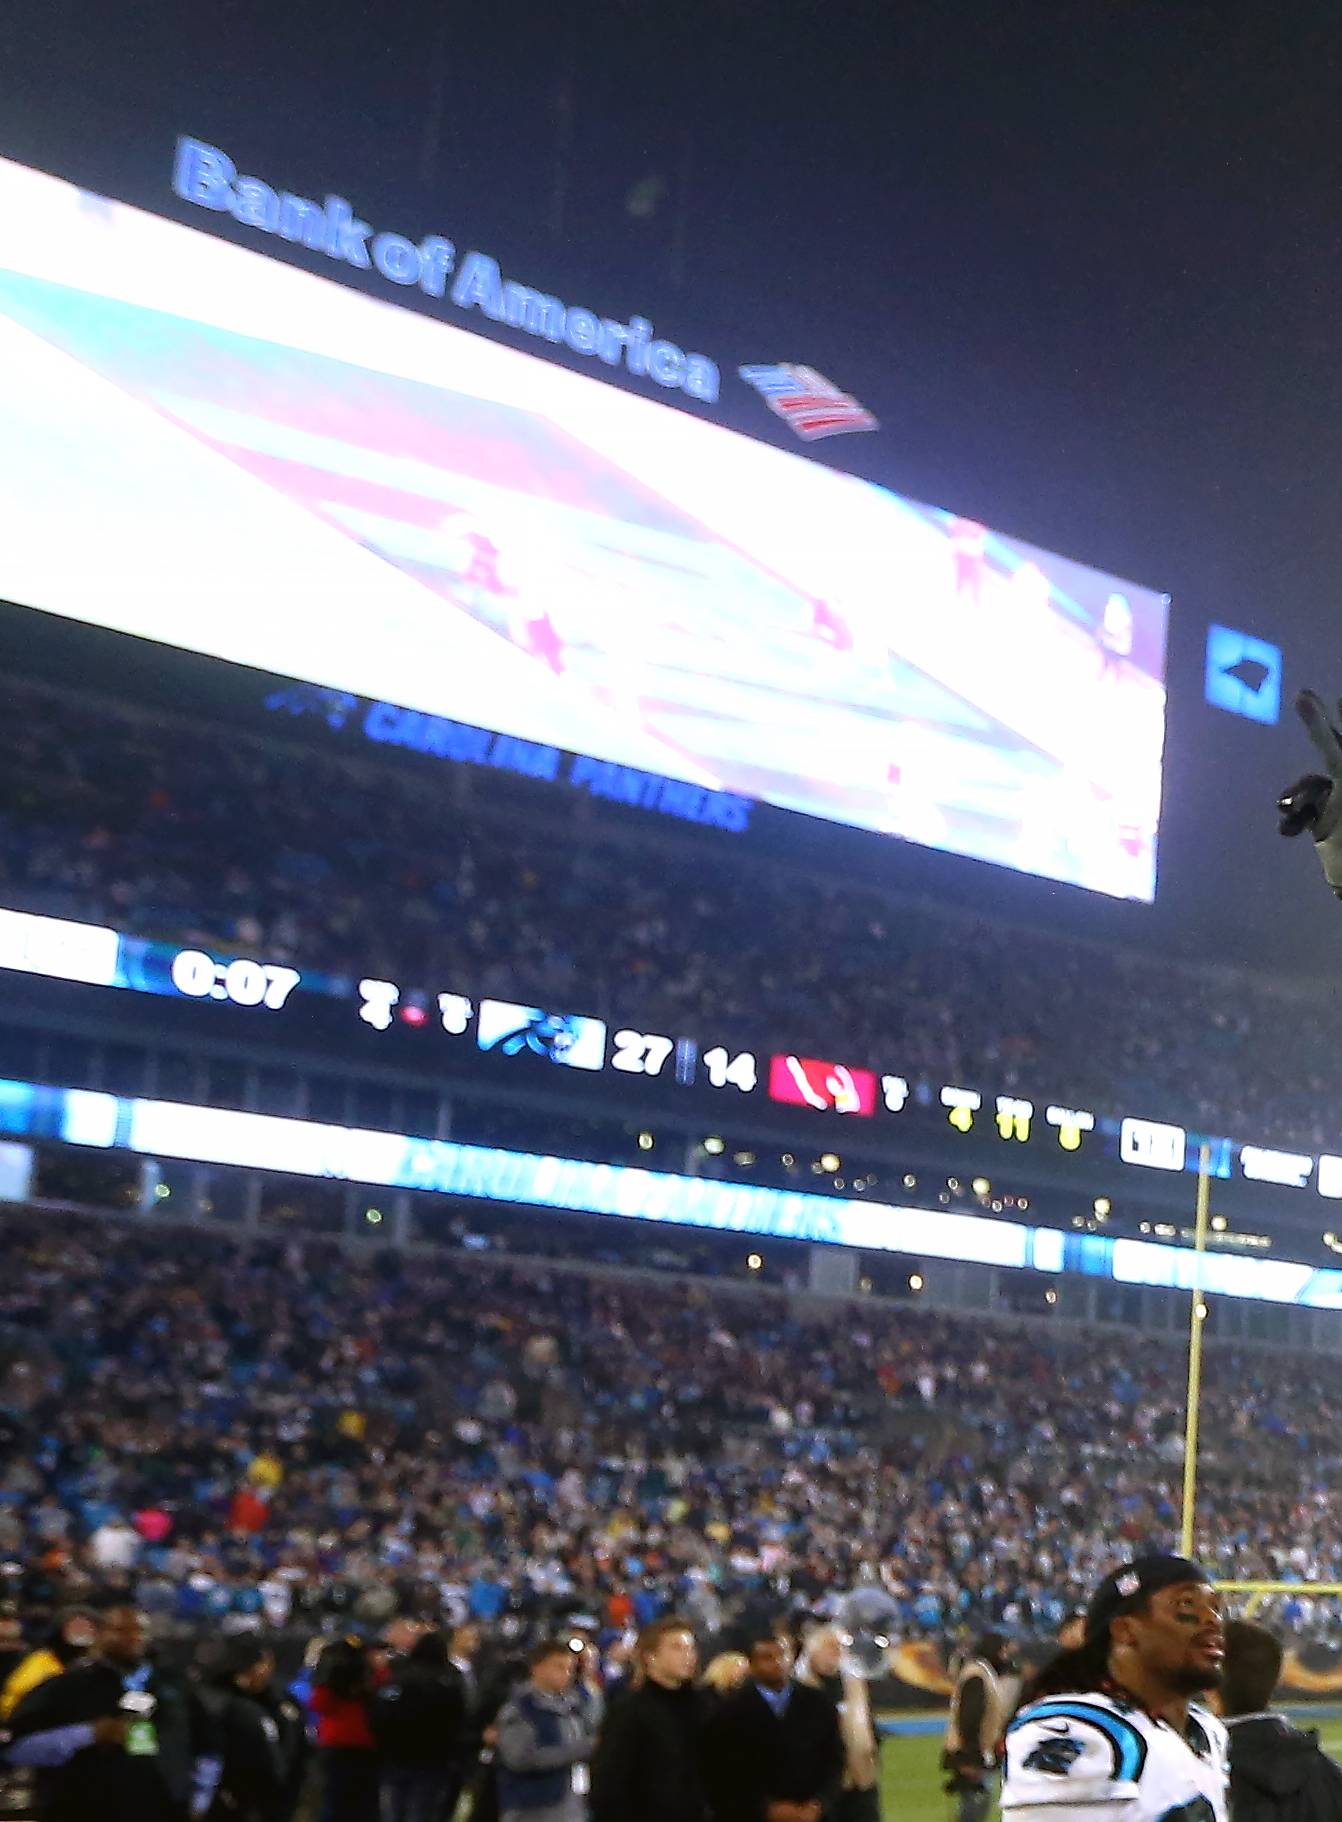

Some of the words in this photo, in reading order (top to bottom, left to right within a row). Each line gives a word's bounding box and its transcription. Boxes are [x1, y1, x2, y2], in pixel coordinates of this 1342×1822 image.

[172, 135, 374, 270] Bank
[372, 232, 456, 298] of
[452, 249, 720, 403] America
[171, 950, 301, 1009] 0:07
[611, 1030, 673, 1075] 27
[702, 1046, 757, 1093] 14
